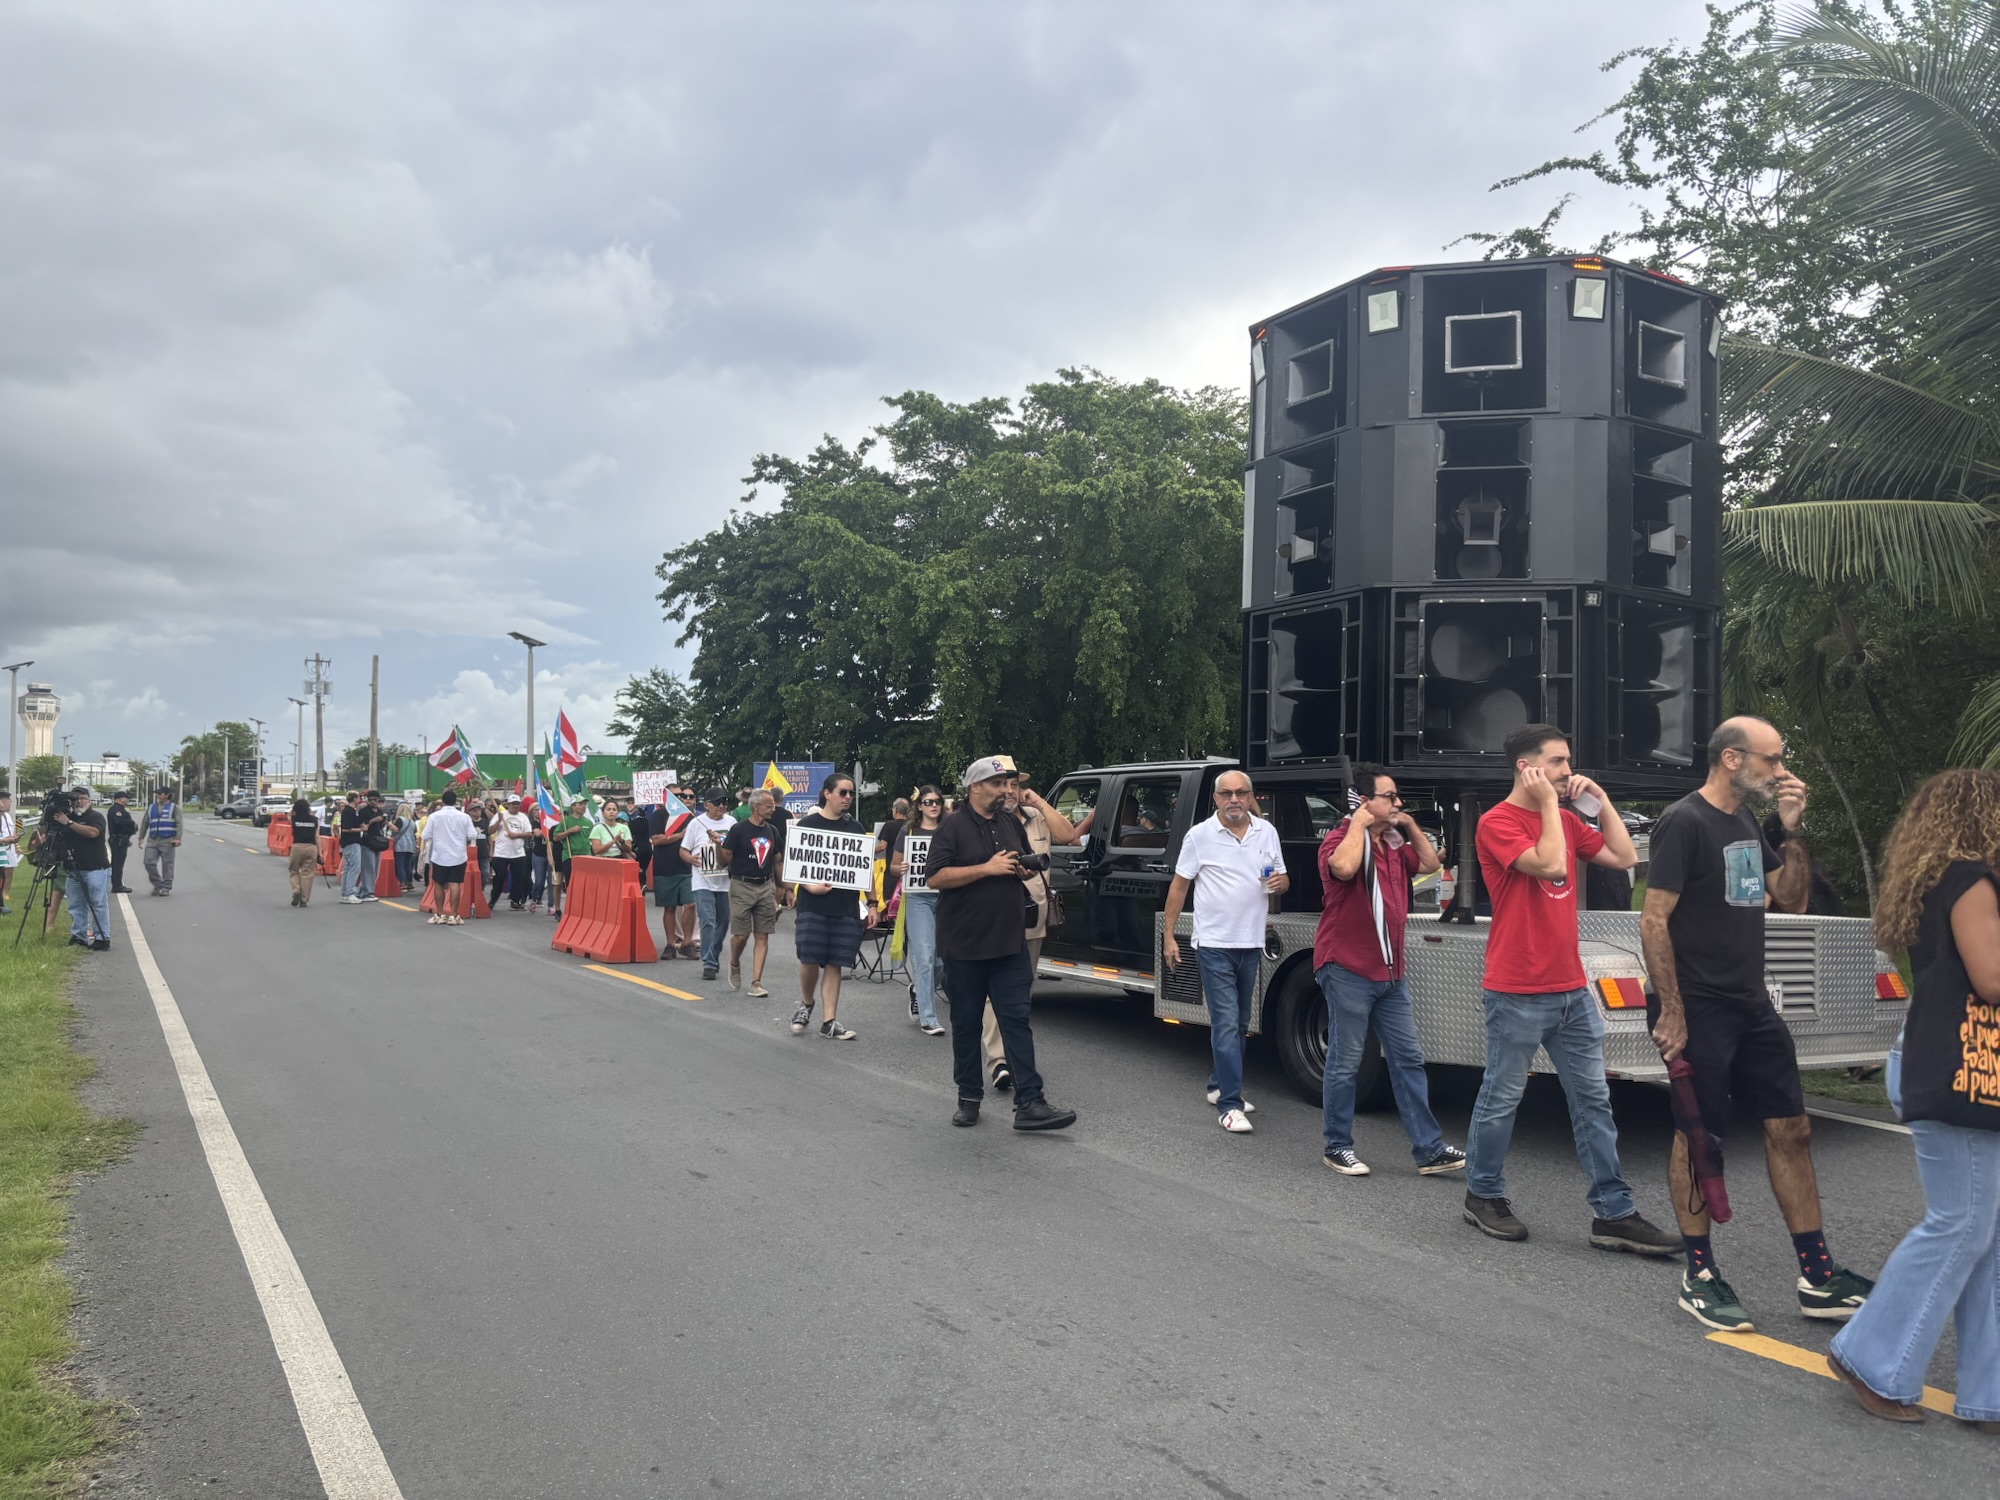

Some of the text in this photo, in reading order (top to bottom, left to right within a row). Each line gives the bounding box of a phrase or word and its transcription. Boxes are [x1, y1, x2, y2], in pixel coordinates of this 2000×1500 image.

[792, 782, 810, 793] DAY
[642, 796, 662, 804] STAT
[800, 832, 863, 853] POR LA PAZ
[912, 841, 927, 851] LA
[789, 847, 870, 870] VAMOS TODAS
[911, 853, 926, 863] ES
[800, 865, 856, 884] A LUCHAR
[910, 865, 926, 875] LU
[910, 877, 926, 887] PO
[1771, 989, 1781, 1006] 67
[1960, 1014, 2000, 1054] el pue
[1963, 1040, 2000, 1075] Salv
[1953, 1062, 2000, 1103] al pue
